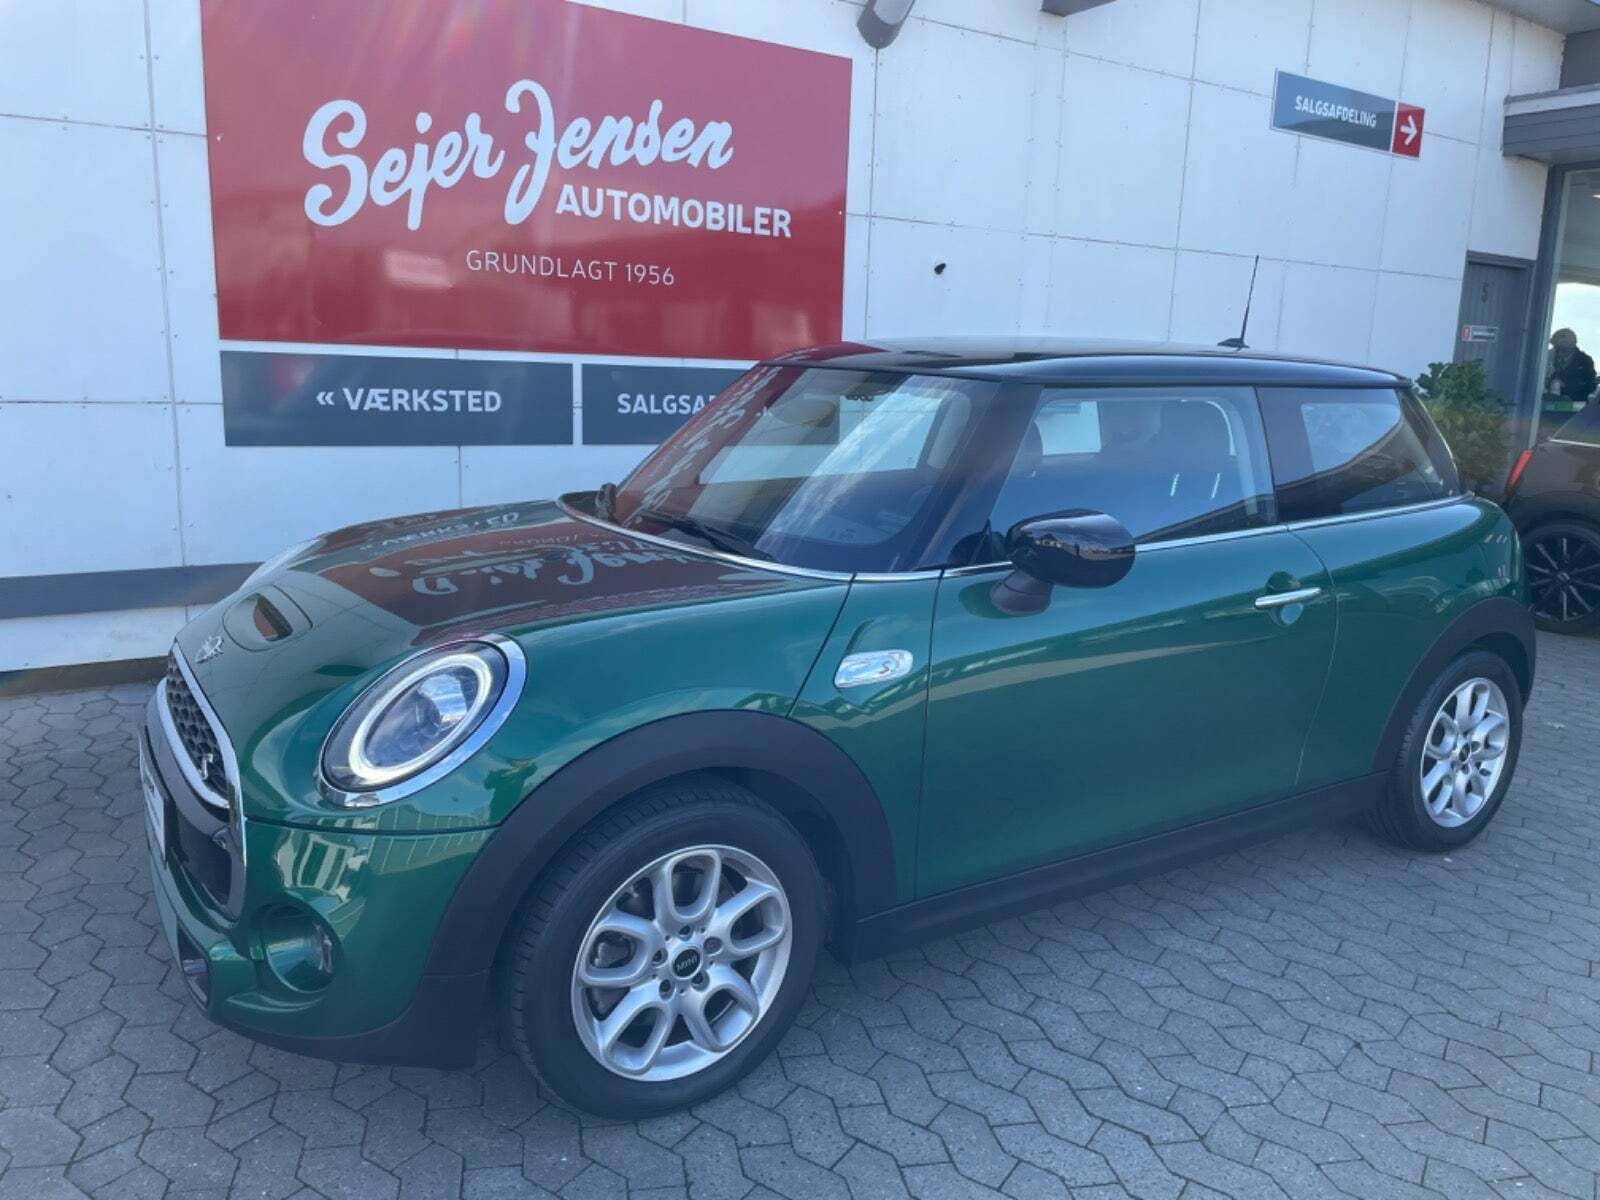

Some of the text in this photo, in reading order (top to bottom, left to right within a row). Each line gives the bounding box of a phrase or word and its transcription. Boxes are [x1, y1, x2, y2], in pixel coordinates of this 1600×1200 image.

[1295, 95, 1376, 127] SALGSAFDELING
[303, 79, 733, 231] Sejer Jensen
[555, 184, 792, 239] AUTOMOBILER
[465, 249, 675, 286] GRUNDLAGT 1956
[342, 387, 503, 413] VÆRKSTED
